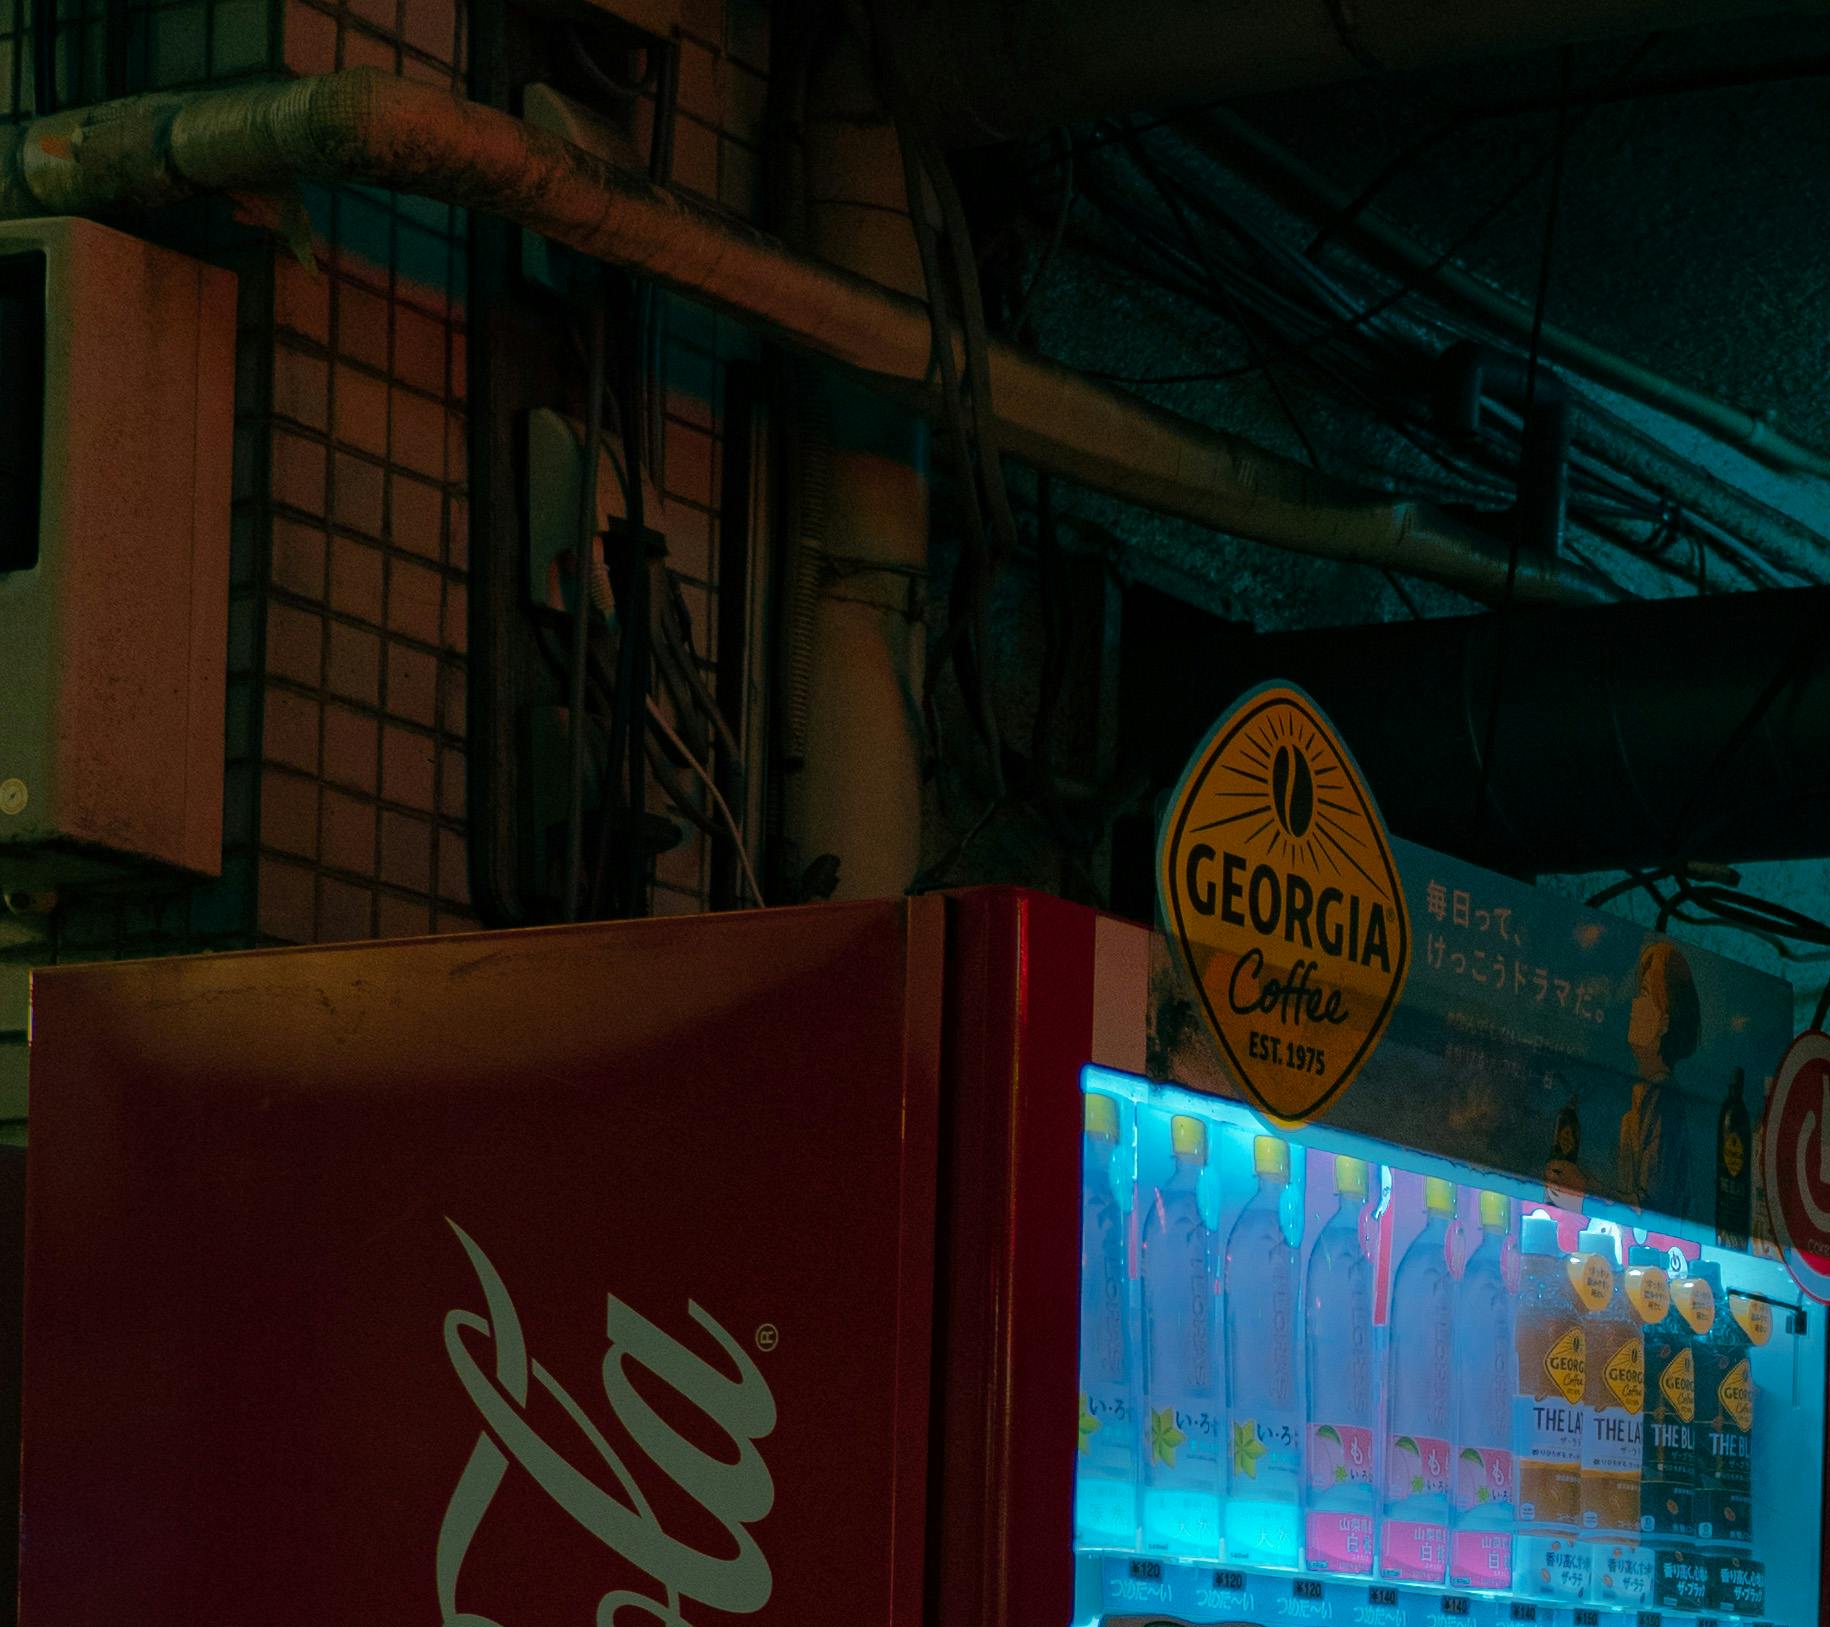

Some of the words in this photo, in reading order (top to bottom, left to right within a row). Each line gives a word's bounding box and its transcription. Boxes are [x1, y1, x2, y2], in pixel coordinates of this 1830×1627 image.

[1186, 843, 1390, 973] GEORGIA
[1427, 879, 1520, 945] 毎日って、
[1229, 948, 1349, 1025] Coffee
[1427, 932, 1605, 1023] けっこうドラマだ。
[1287, 1042, 1324, 1076] 1975
[1534, 1407, 1565, 1432] THE
[1594, 1419, 1625, 1440] THE
[1651, 1424, 1676, 1447] THE
[1709, 1433, 1736, 1456] THE
